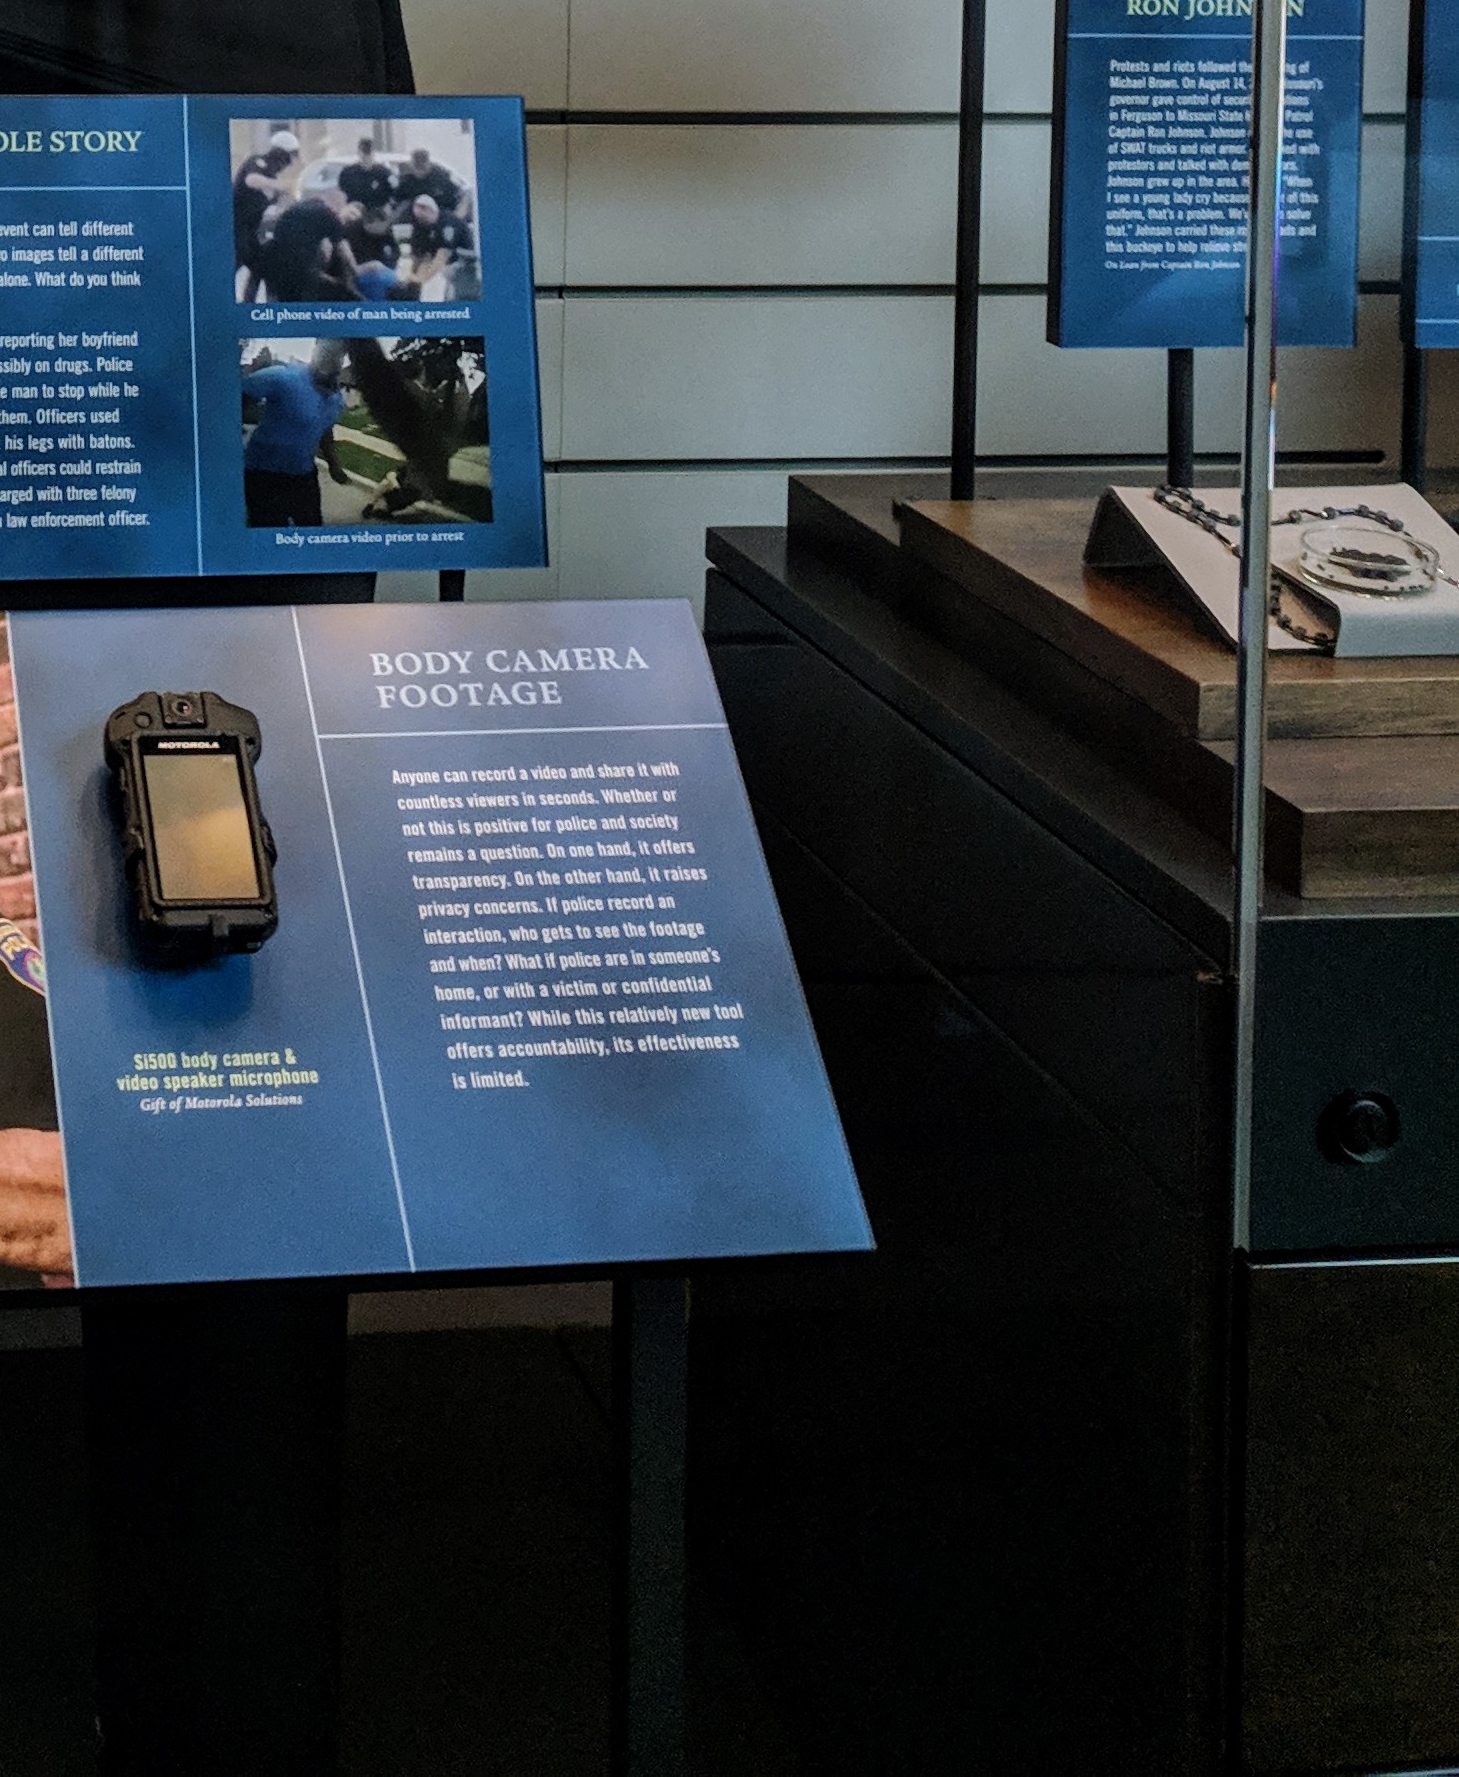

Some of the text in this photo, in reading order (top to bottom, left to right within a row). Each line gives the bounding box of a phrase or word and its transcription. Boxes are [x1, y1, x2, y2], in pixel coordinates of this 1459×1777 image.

[49, 130, 142, 153] STORY
[32, 224, 55, 237] can
[58, 221, 78, 237] tell
[81, 220, 135, 237] different
[250, 306, 471, 324] Cell phone video of man being arrested
[275, 530, 465, 548] Body camera video prior to arrest
[368, 646, 650, 676] BODY CAMERA
[375, 680, 562, 709] FOOTAGE
[157, 741, 220, 749] MOTOROLA
[392, 761, 680, 787] Anyone can record a video and share it with
[133, 1048, 297, 1070] Si500 body camera &
[116, 1068, 319, 1092] video speaker microphone
[139, 1093, 304, 1114] Gift of Motorola Solutions
